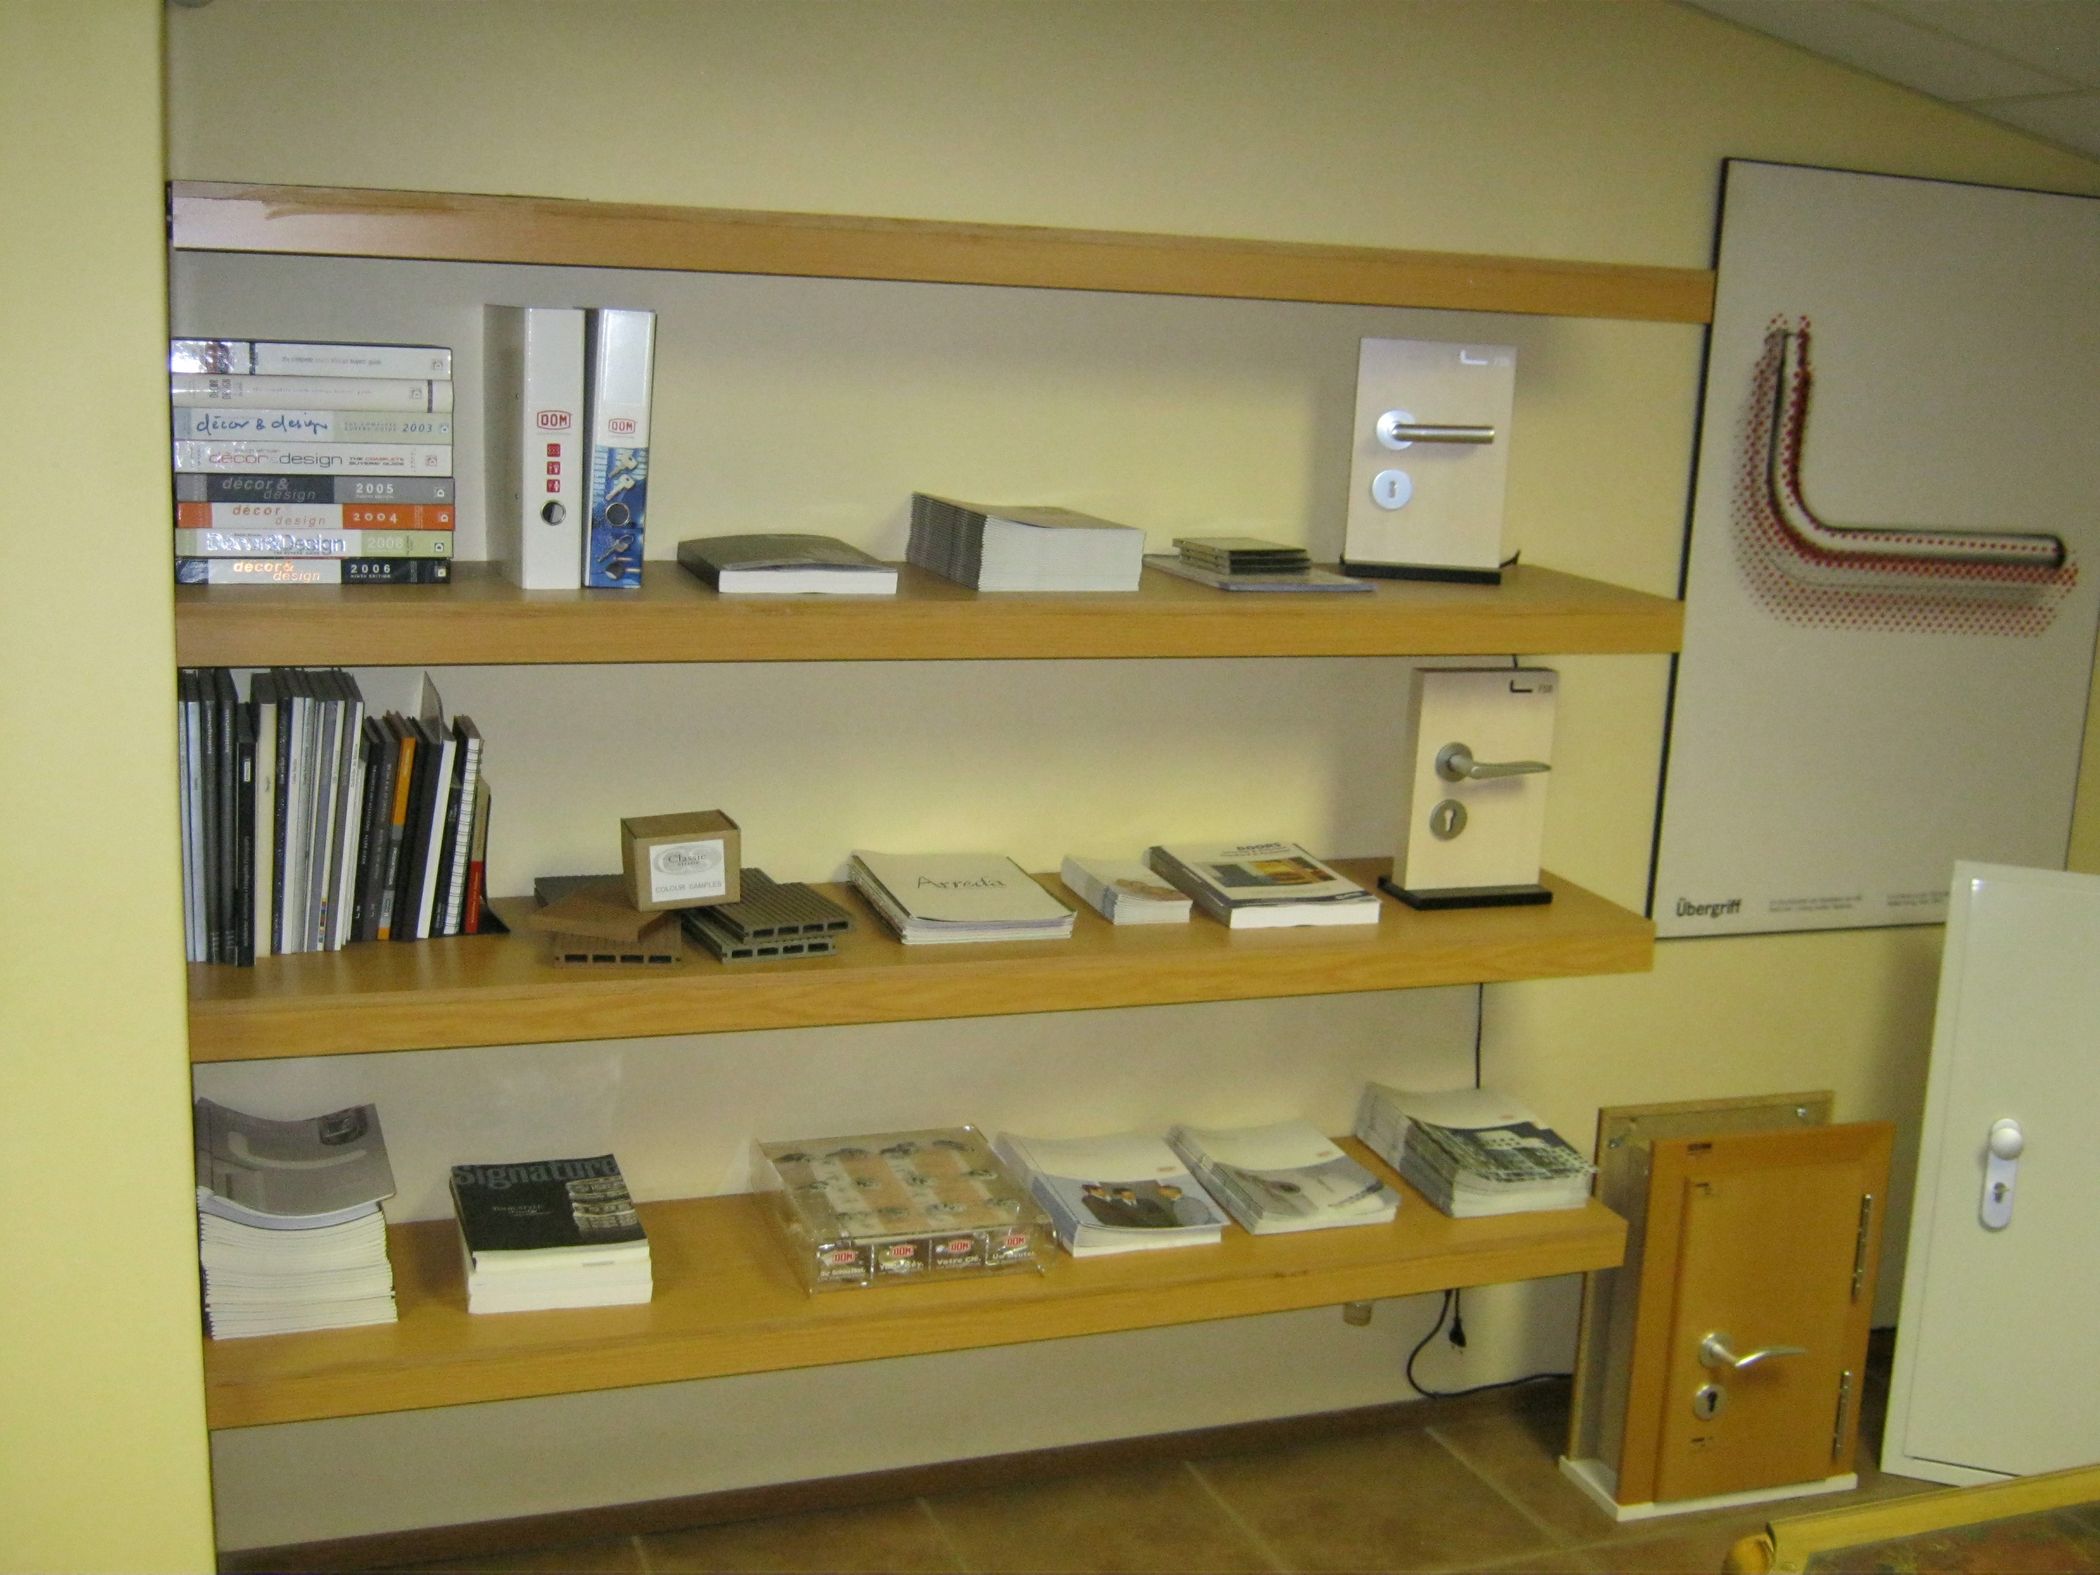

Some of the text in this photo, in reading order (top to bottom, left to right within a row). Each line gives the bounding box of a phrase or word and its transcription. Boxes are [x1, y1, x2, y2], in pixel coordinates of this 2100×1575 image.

[256, 418, 266, 431] &
[541, 413, 568, 427] DOM
[402, 423, 433, 434] 2003
[611, 421, 633, 432] DOM
[280, 452, 343, 469] design
[277, 478, 289, 491] &
[356, 483, 394, 494] 2005
[263, 489, 316, 503] design
[275, 516, 326, 528] design
[353, 512, 398, 524] 2004
[350, 564, 391, 574] 2006
[272, 571, 320, 583] design
[655, 881, 722, 893] COLOUR SAMPLES
[1676, 897, 1742, 919] Übergriff
[455, 1158, 620, 1190] Signature
